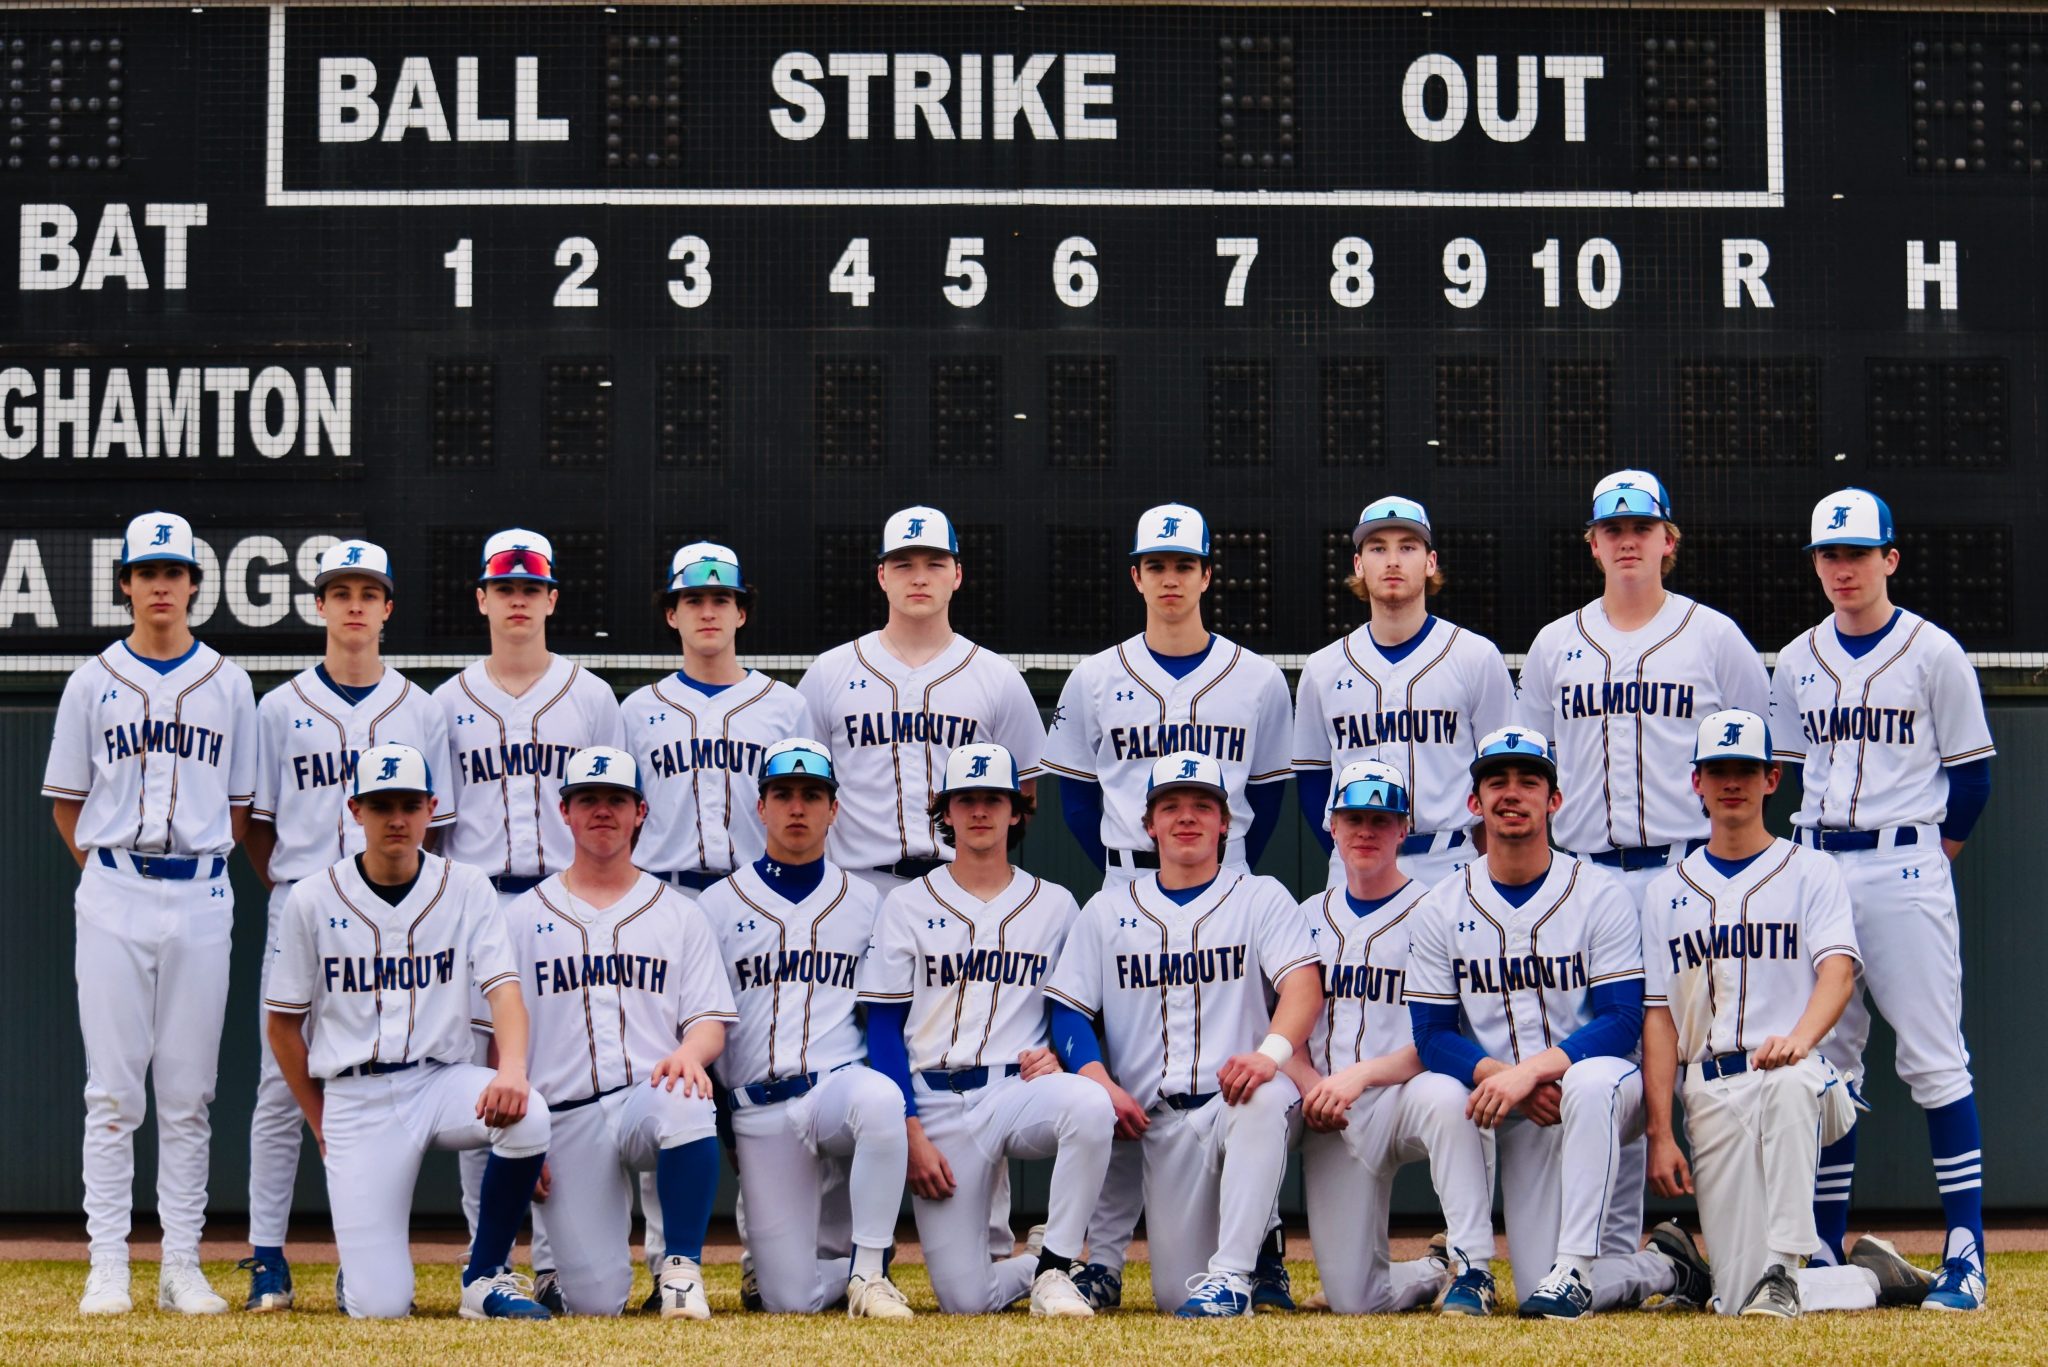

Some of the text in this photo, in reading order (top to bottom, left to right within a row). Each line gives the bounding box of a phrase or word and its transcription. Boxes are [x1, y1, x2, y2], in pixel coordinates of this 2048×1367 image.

[319, 51, 1605, 143] BALL STRIKE OUT
[19, 203, 209, 291] BAT
[443, 236, 1959, 310] 1 2 3 4 5 6 7 8 9 10 R H
[0, 366, 353, 461] GHAMTON
[1560, 681, 1695, 720] FALMOUTH
[103, 719, 224, 768] FALMOUTH
[844, 710, 978, 749] FALMOUTH
[1110, 723, 1247, 762] FALMOUTH
[1332, 709, 1458, 750] FALMOUTH
[459, 742, 584, 786] FALMOUT
[323, 947, 456, 993] FALMOUTH
[735, 949, 859, 992] FALMOUTH
[925, 948, 1049, 987] FALMOUTH
[1116, 944, 1247, 989] FALMOUTH
[1668, 922, 1798, 975] FALMOUTH
[534, 953, 669, 997] FALMOUTH
[1320, 963, 1406, 1006] LMOUT
[1452, 951, 1588, 994] FALMOUTH
